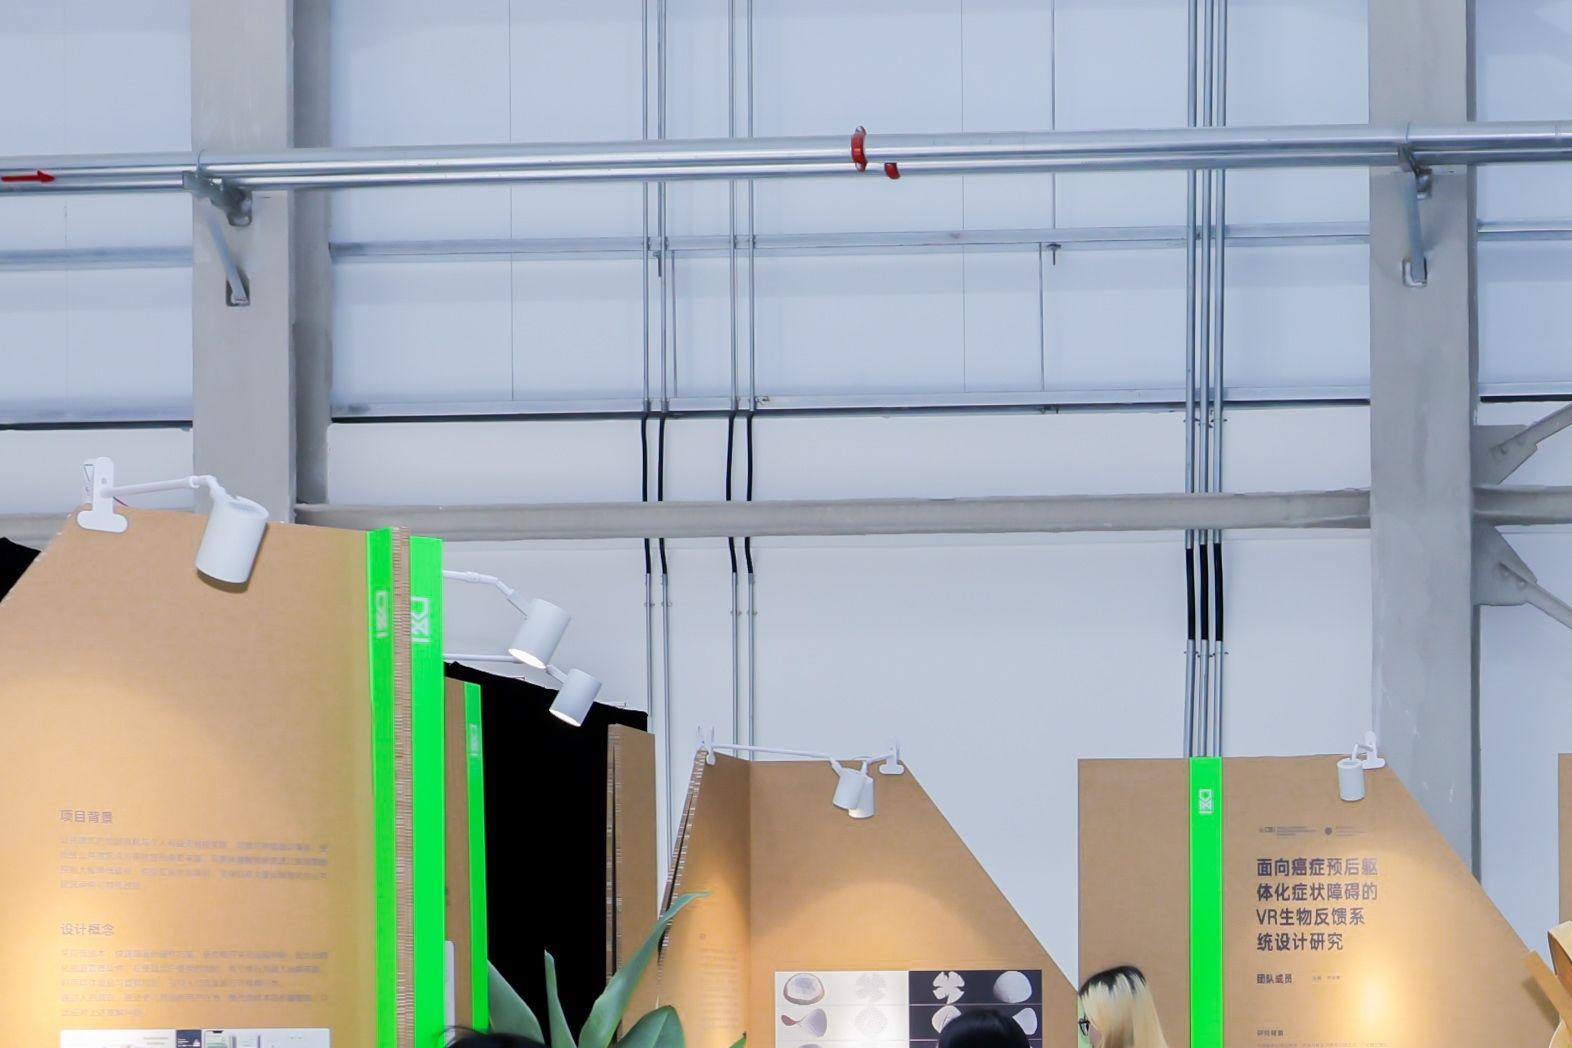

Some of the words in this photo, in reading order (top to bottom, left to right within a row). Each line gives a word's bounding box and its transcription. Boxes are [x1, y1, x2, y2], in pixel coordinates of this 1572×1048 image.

[60, 810, 113, 825] 项目背景
[1256, 857, 1379, 877] 面向癌症预后躯
[1256, 882, 1378, 902] 体化症状障碍的
[1256, 907, 1366, 926] VR生物反馈系
[60, 923, 115, 936] 设计概念
[1256, 932, 1344, 951] 统设计研究
[1256, 973, 1293, 984] 团队成员
